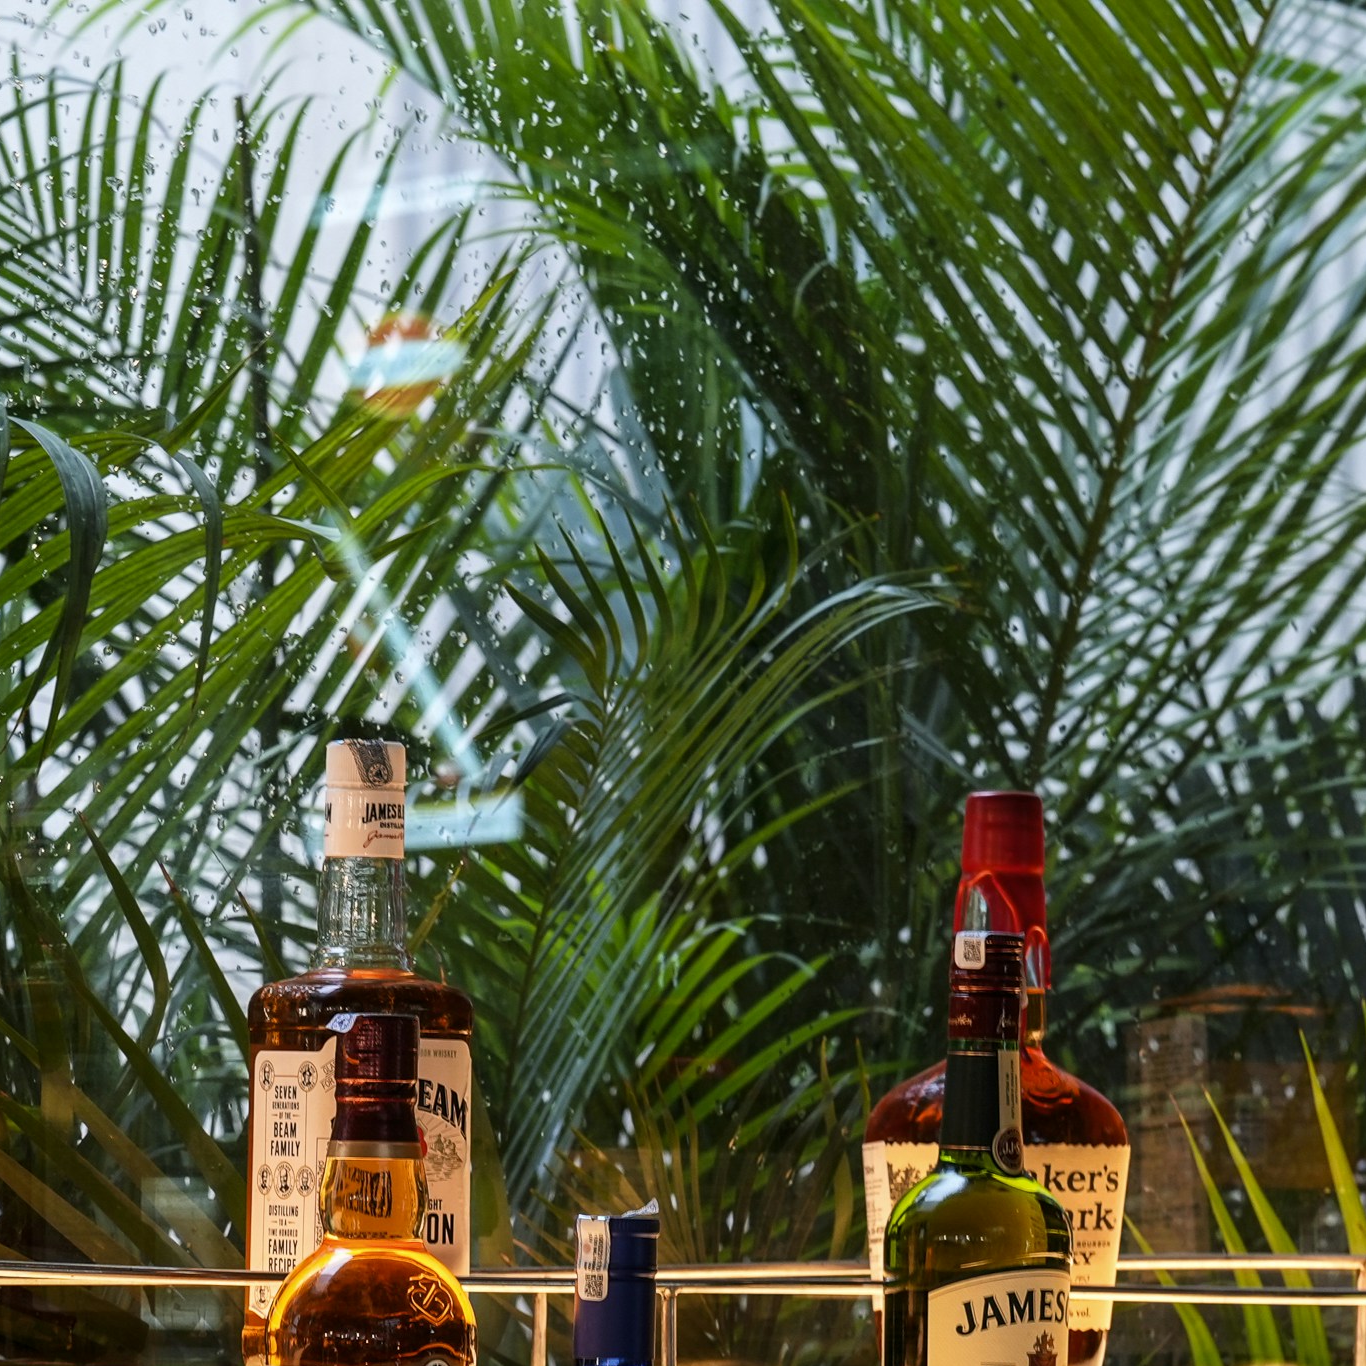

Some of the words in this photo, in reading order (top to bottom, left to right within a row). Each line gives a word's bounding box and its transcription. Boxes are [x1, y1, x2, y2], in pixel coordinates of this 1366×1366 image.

[362, 803, 397, 823] JAMES
[434, 1050, 457, 1058] WHISKEY
[275, 1086, 297, 1099] SEVEN
[272, 1101, 300, 1110] GENERATIONS
[418, 1078, 468, 1140] EAM
[273, 1122, 297, 1138] BEAM
[271, 1141, 300, 1157] FAMILY
[1029, 1163, 1119, 1193] ker's
[269, 1205, 299, 1217] DISTILLING
[268, 1228, 277, 1236] TIME
[279, 1229, 298, 1237] HONORED
[269, 1239, 298, 1255] FAMILY
[269, 1258, 296, 1272] RECIPE
[1077, 1307, 1091, 1318] vol.
